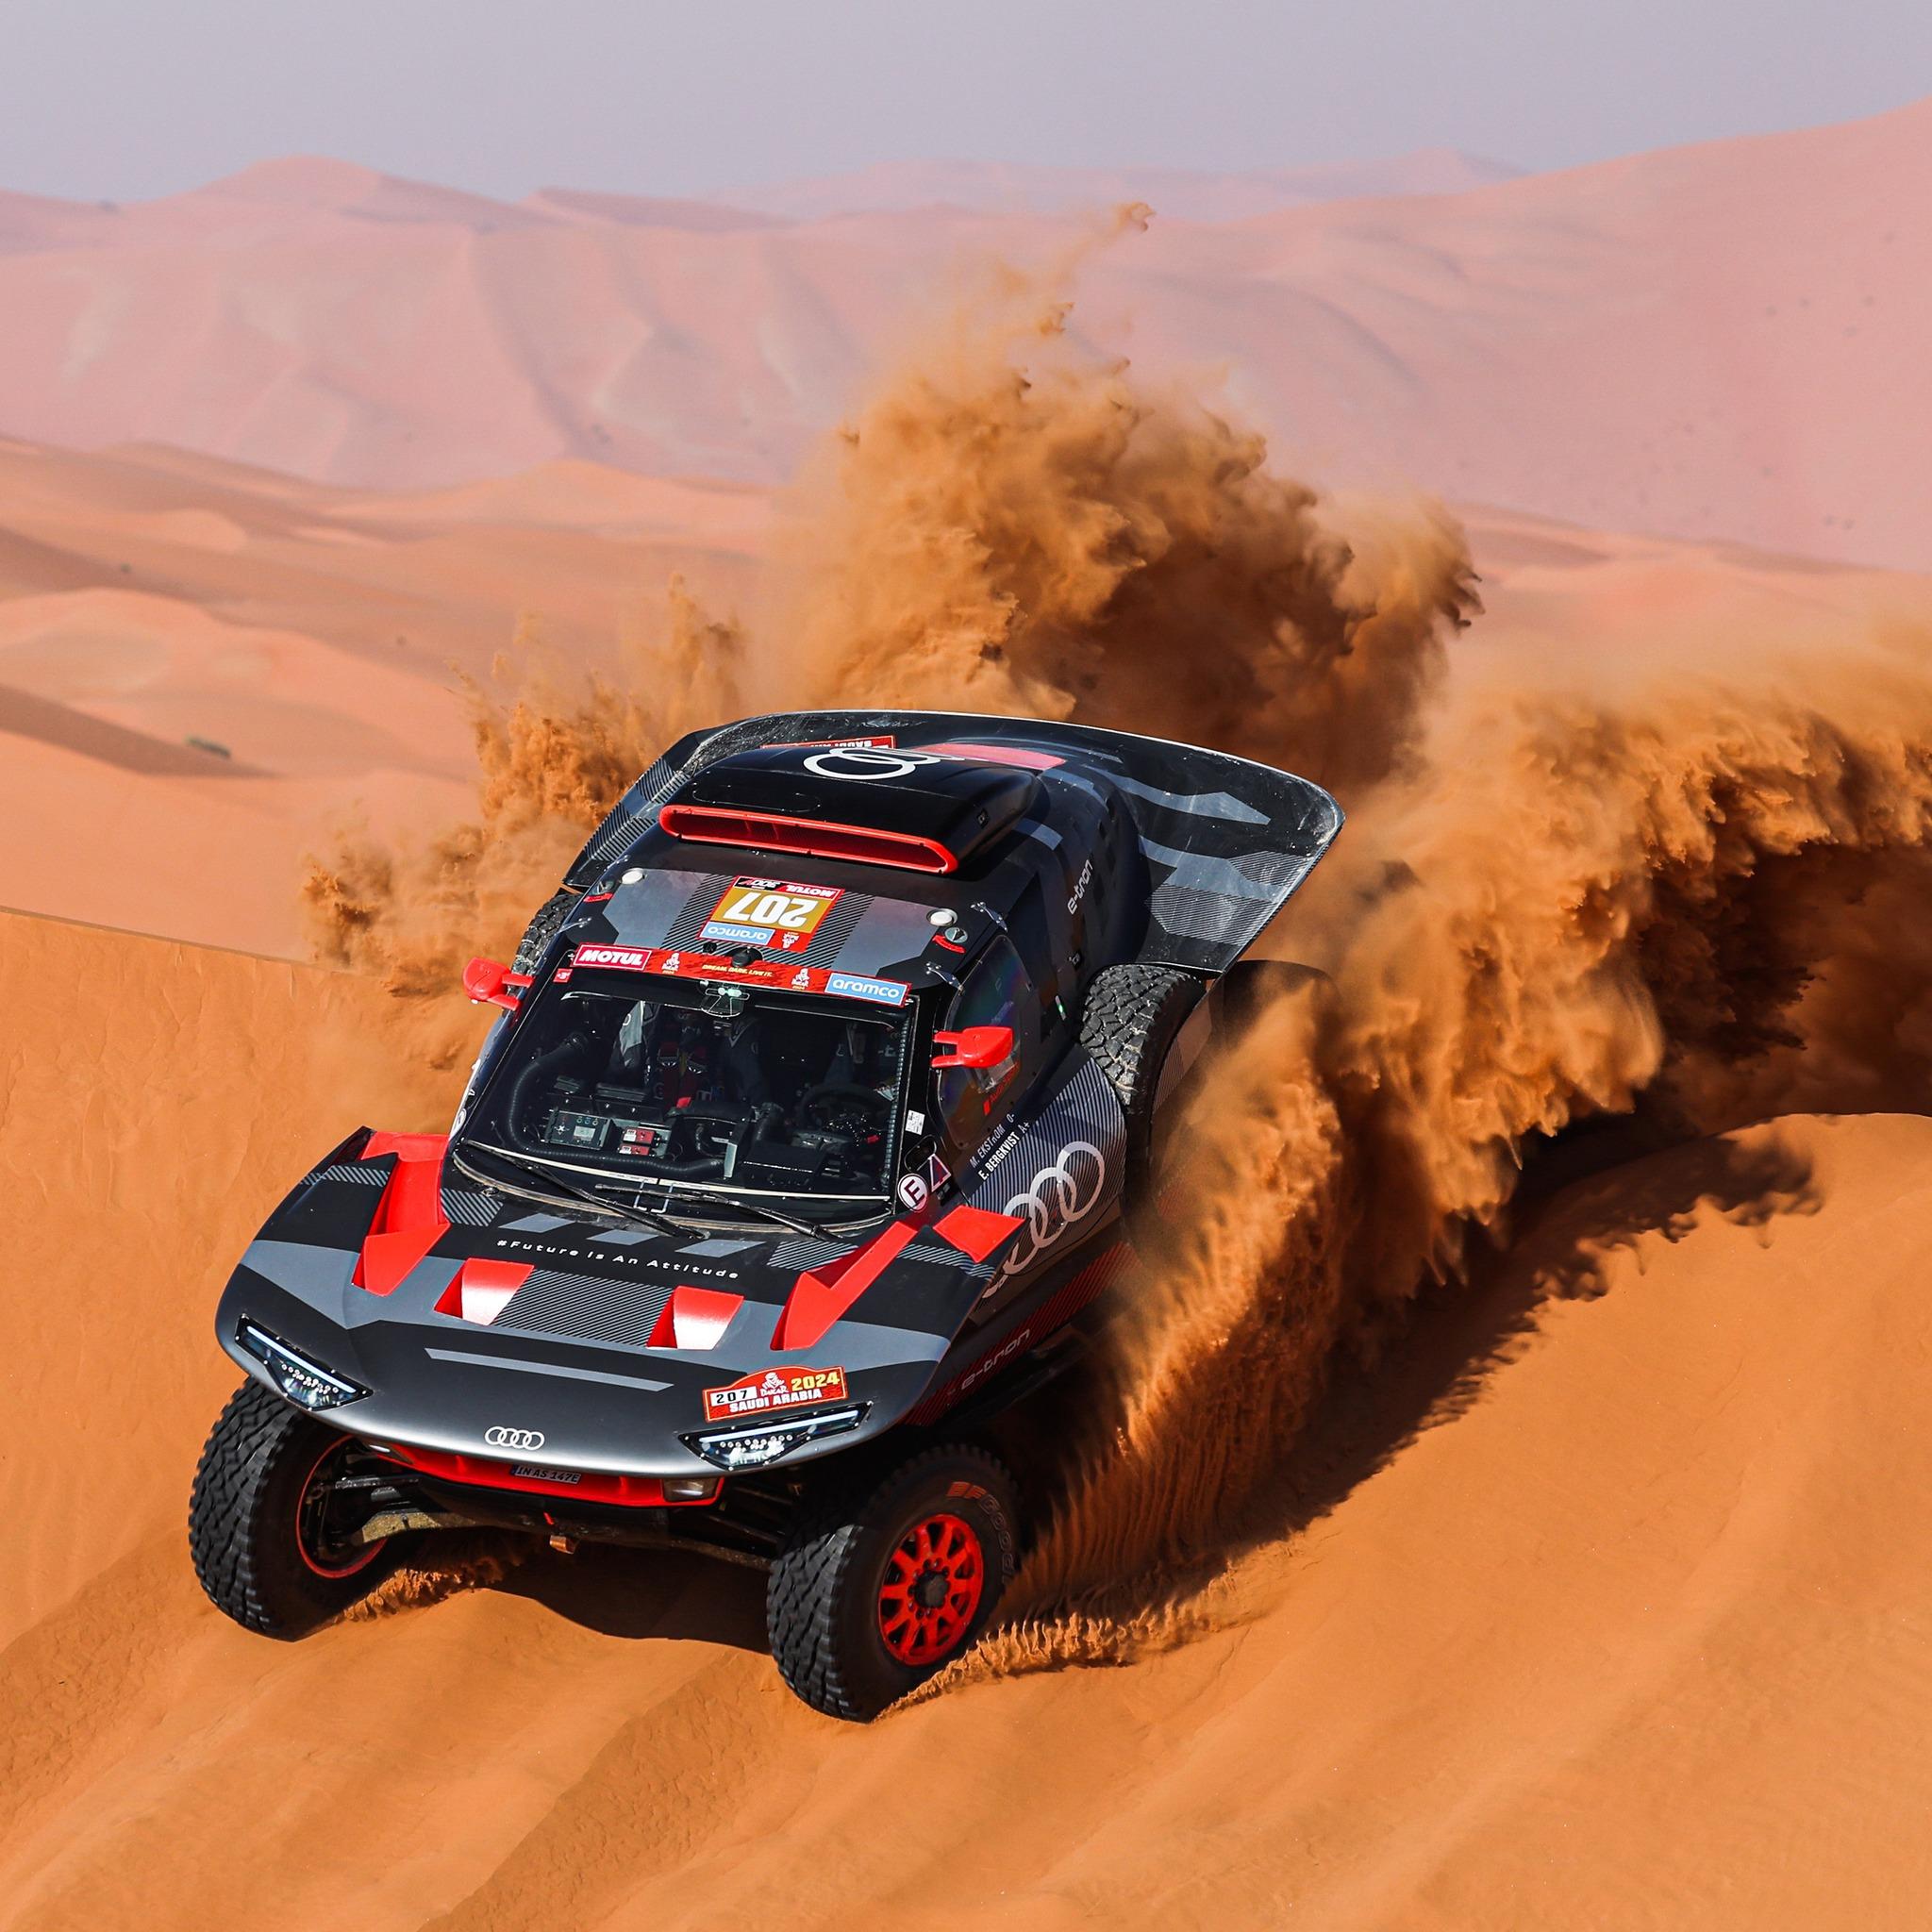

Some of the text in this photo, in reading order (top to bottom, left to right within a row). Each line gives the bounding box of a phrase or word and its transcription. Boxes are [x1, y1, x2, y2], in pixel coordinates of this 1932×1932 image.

[785, 884, 837, 897] MOTUL
[1067, 858, 1093, 915] e-tron
[722, 891, 819, 928] 207
[708, 925, 768, 941] aramco
[578, 949, 643, 966] MOTUL
[832, 977, 900, 999] aramco
[977, 1170, 990, 1181] E.
[984, 1131, 1021, 1173] BERGKVIST
[496, 1240, 579, 1257] #Future
[612, 1254, 639, 1265] An
[646, 1259, 739, 1279] Attitude
[791, 1372, 841, 1392] 2024
[716, 1390, 748, 1405] 207
[728, 1388, 823, 1413] SAUDI ARABIA
[533, 1469, 548, 1478] AS
[549, 1471, 580, 1483] 147E
